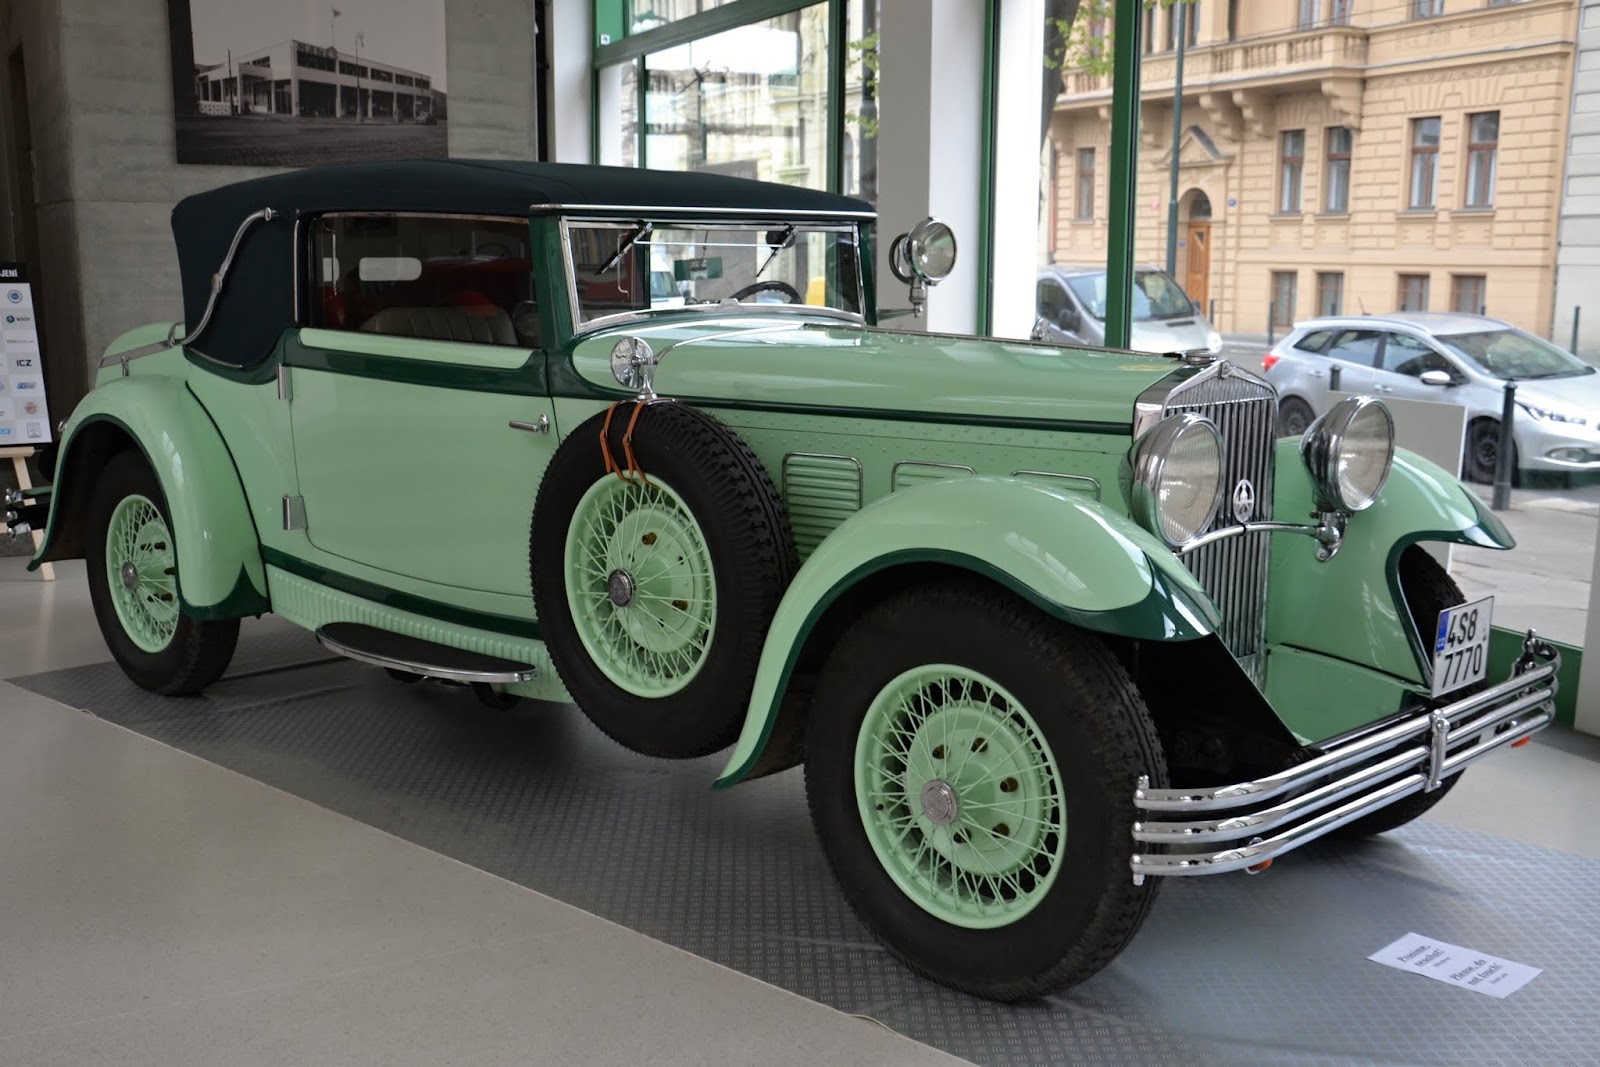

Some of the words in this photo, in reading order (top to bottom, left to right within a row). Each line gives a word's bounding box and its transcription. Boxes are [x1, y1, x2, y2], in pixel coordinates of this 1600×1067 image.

[16, 359, 32, 367] ICZ
[1447, 608, 1478, 648] 4S8
[1442, 643, 1483, 688] 7770
